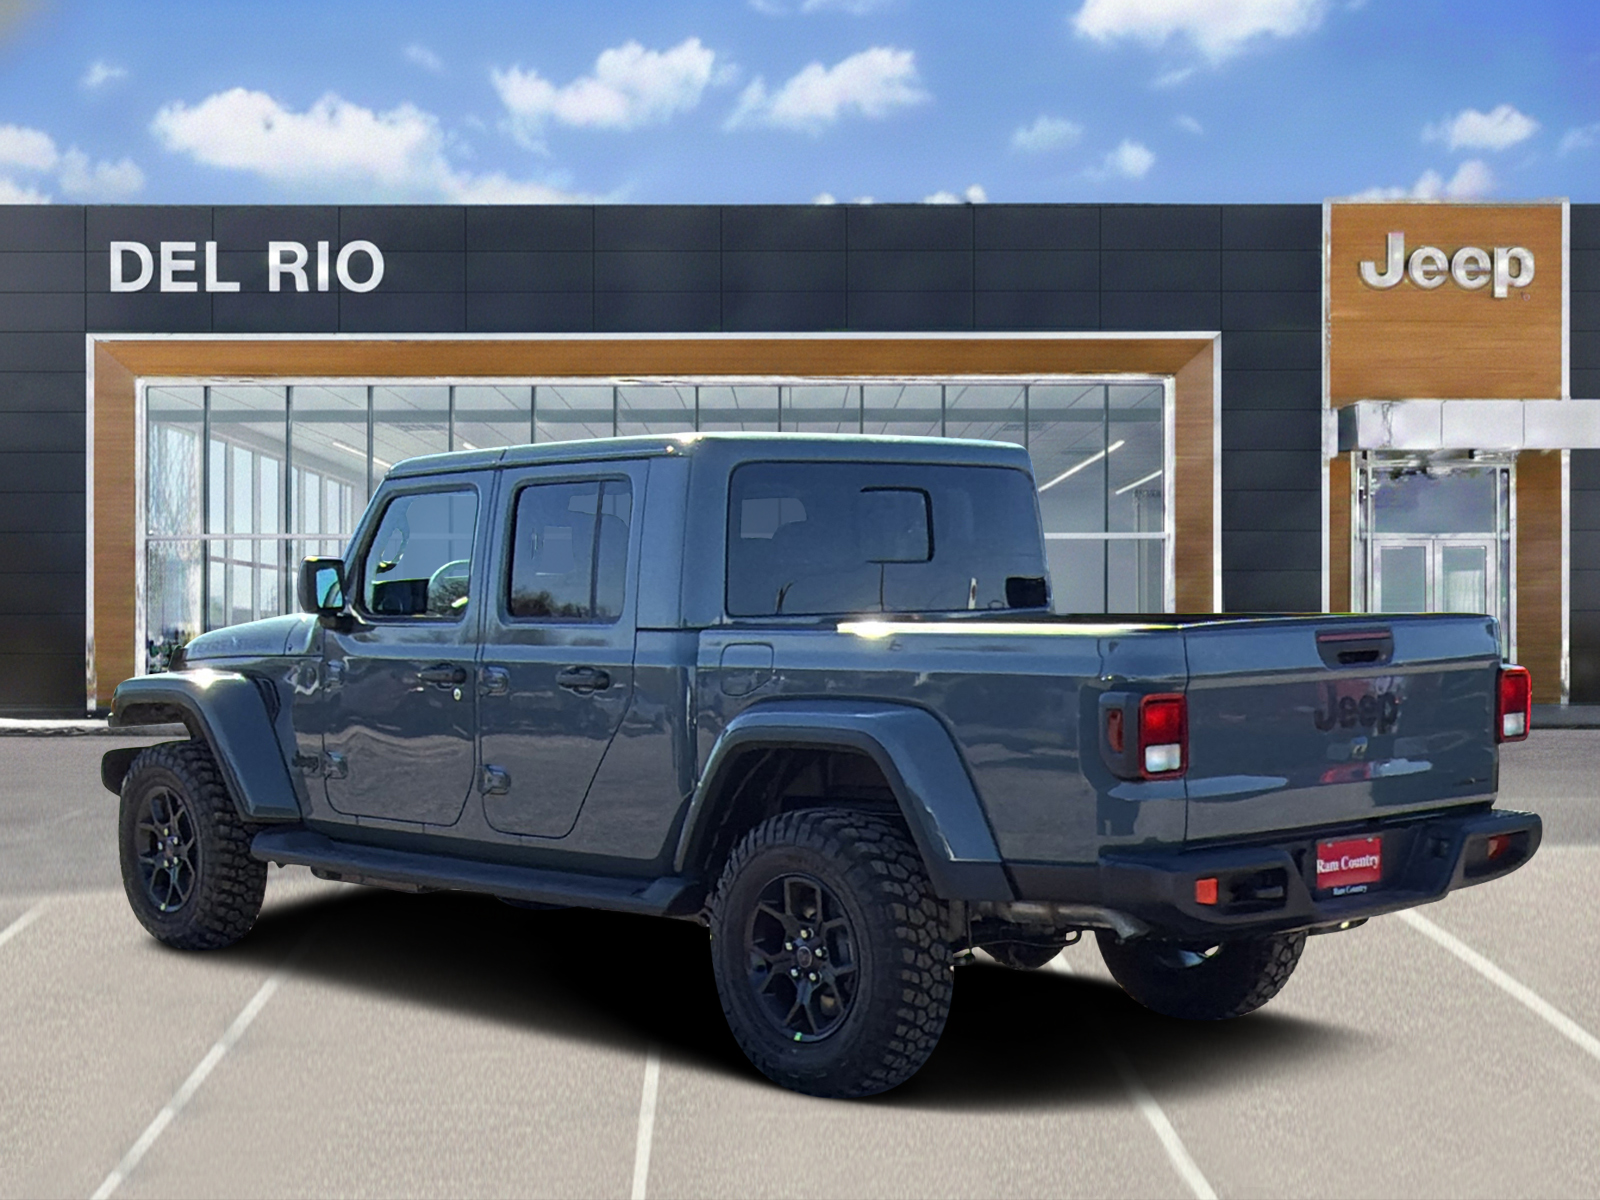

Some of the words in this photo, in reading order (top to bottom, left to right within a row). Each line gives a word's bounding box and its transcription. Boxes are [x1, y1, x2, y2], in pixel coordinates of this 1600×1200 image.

[110, 241, 241, 293] DEL
[268, 240, 385, 293] RIO
[1358, 231, 1536, 299] Jeep
[1313, 682, 1399, 735] Jeep
[1316, 859, 1340, 874] Ram
[1340, 855, 1380, 871] Country
